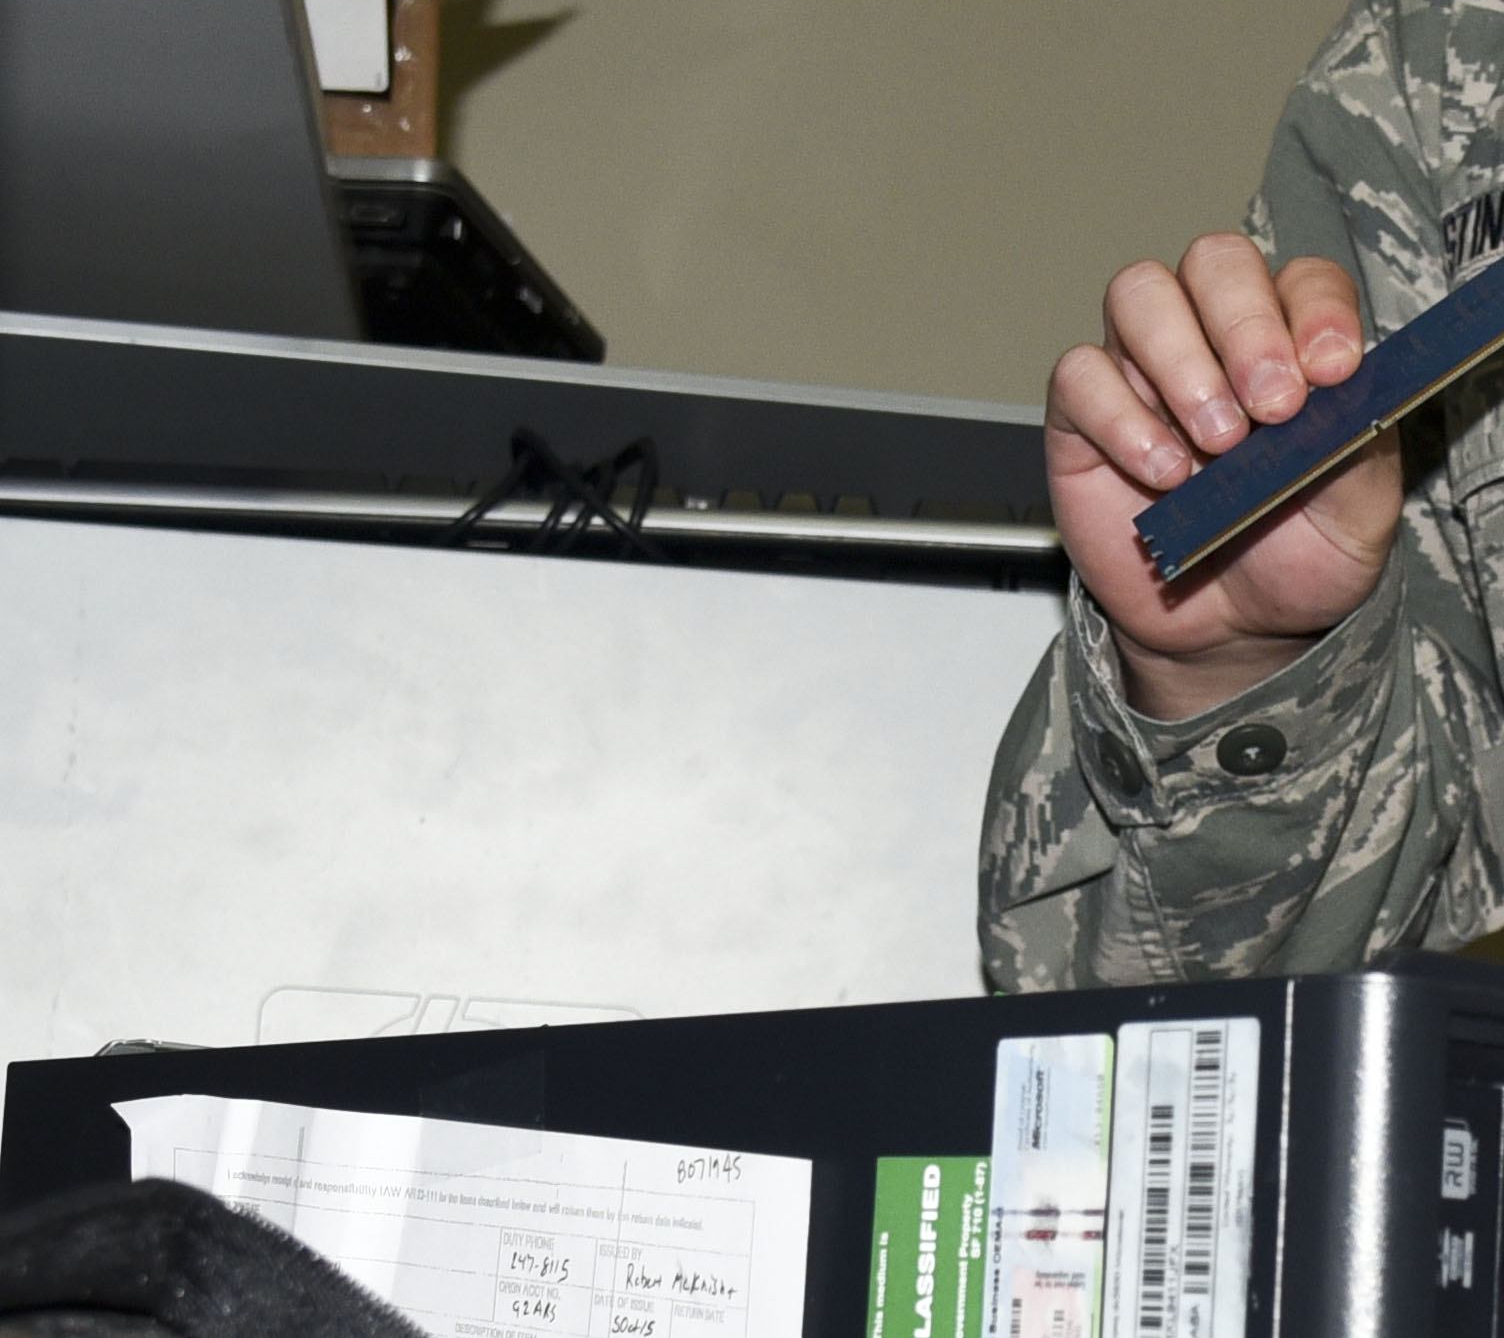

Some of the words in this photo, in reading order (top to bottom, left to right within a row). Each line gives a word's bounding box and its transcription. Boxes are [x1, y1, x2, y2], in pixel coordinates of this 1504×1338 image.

[1031, 1069, 1045, 1150] Microsoft
[958, 1193, 974, 1258] Property
[971, 1206, 984, 1233] 710
[503, 1232, 525, 1247] DUTY
[878, 1232, 889, 1246] is
[970, 1238, 981, 1259] SF
[631, 1246, 643, 1261] BY
[876, 1249, 889, 1308] medium
